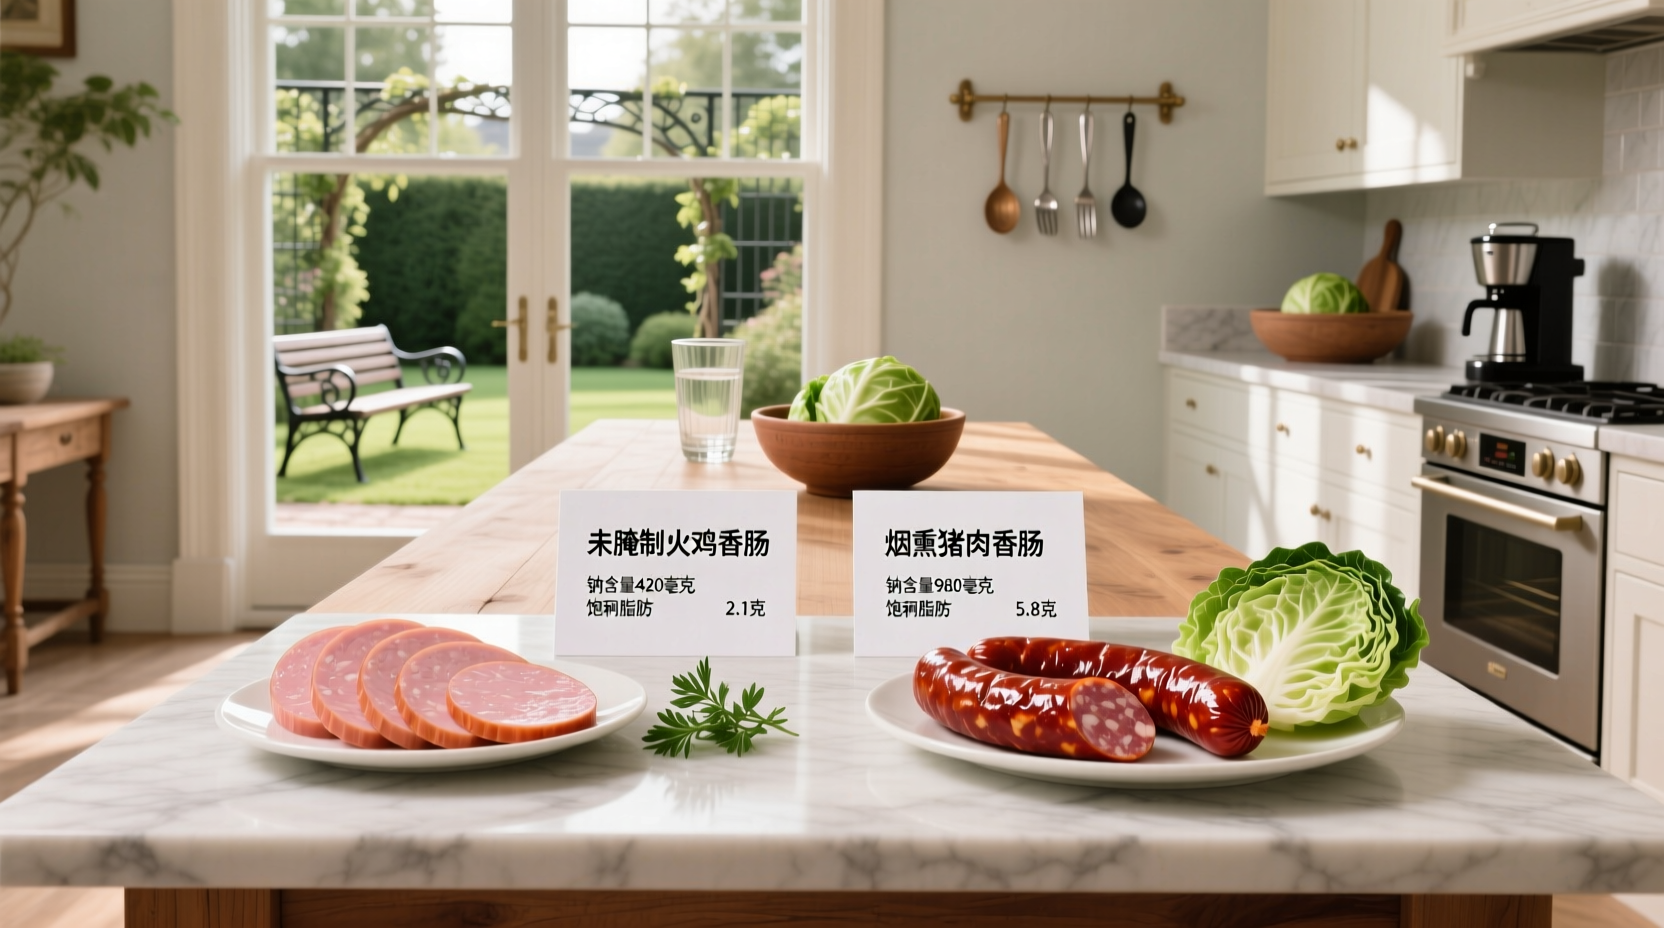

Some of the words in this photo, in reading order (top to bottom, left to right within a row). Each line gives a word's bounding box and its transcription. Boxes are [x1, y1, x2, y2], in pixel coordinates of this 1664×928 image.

[586, 528, 770, 557] 未腌制火鸡香肠
[885, 528, 1044, 558] 烟熏猪肉香肠
[725, 598, 766, 617] 2.1克
[1016, 599, 1057, 618] 5.8克
